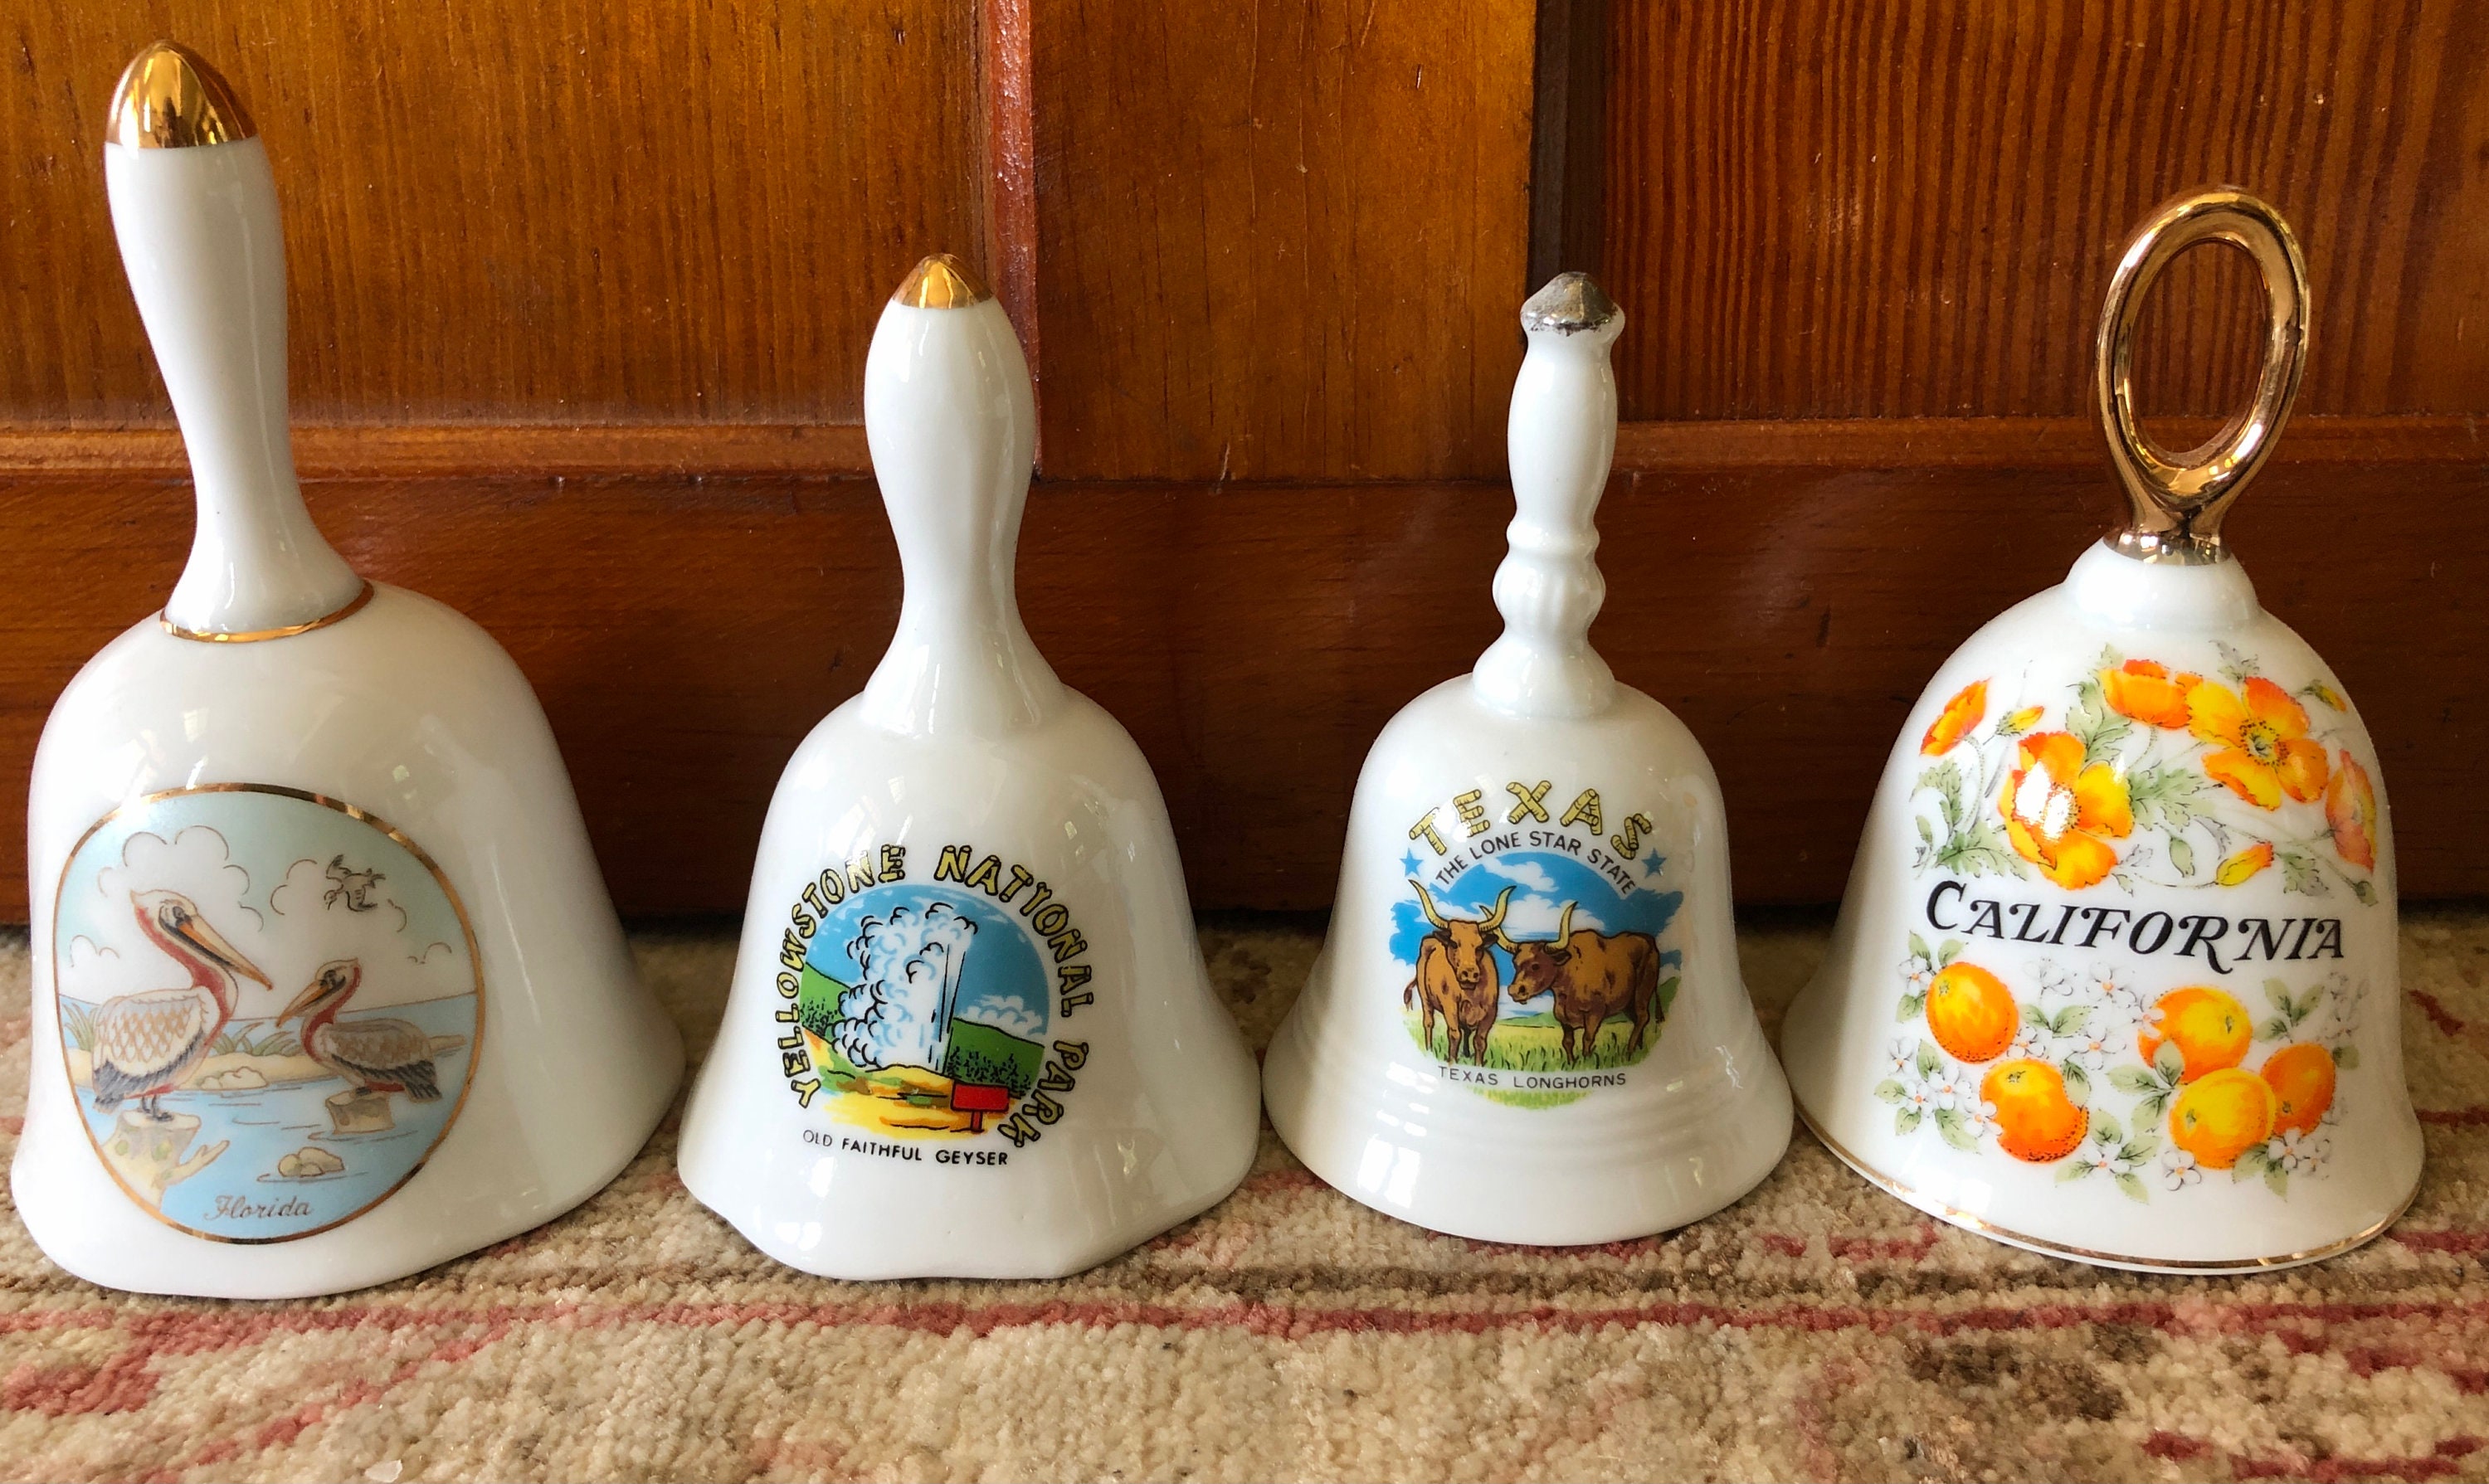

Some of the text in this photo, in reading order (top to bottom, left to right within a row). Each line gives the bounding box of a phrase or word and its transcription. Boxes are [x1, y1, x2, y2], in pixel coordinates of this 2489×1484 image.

[1409, 780, 1652, 860] TEXAS
[1435, 831, 1635, 896] THE LONE STAR STATE
[1926, 880, 2345, 974] CALIFORNIA
[776, 844, 1094, 1147] YELLOWSTONE NATIONAL PARK
[1438, 1065, 1626, 1089] TEXAS LONGHORNS
[802, 1129, 1008, 1165] OLD FAITHFUL GEYSER
[204, 1194, 312, 1221] Florida
